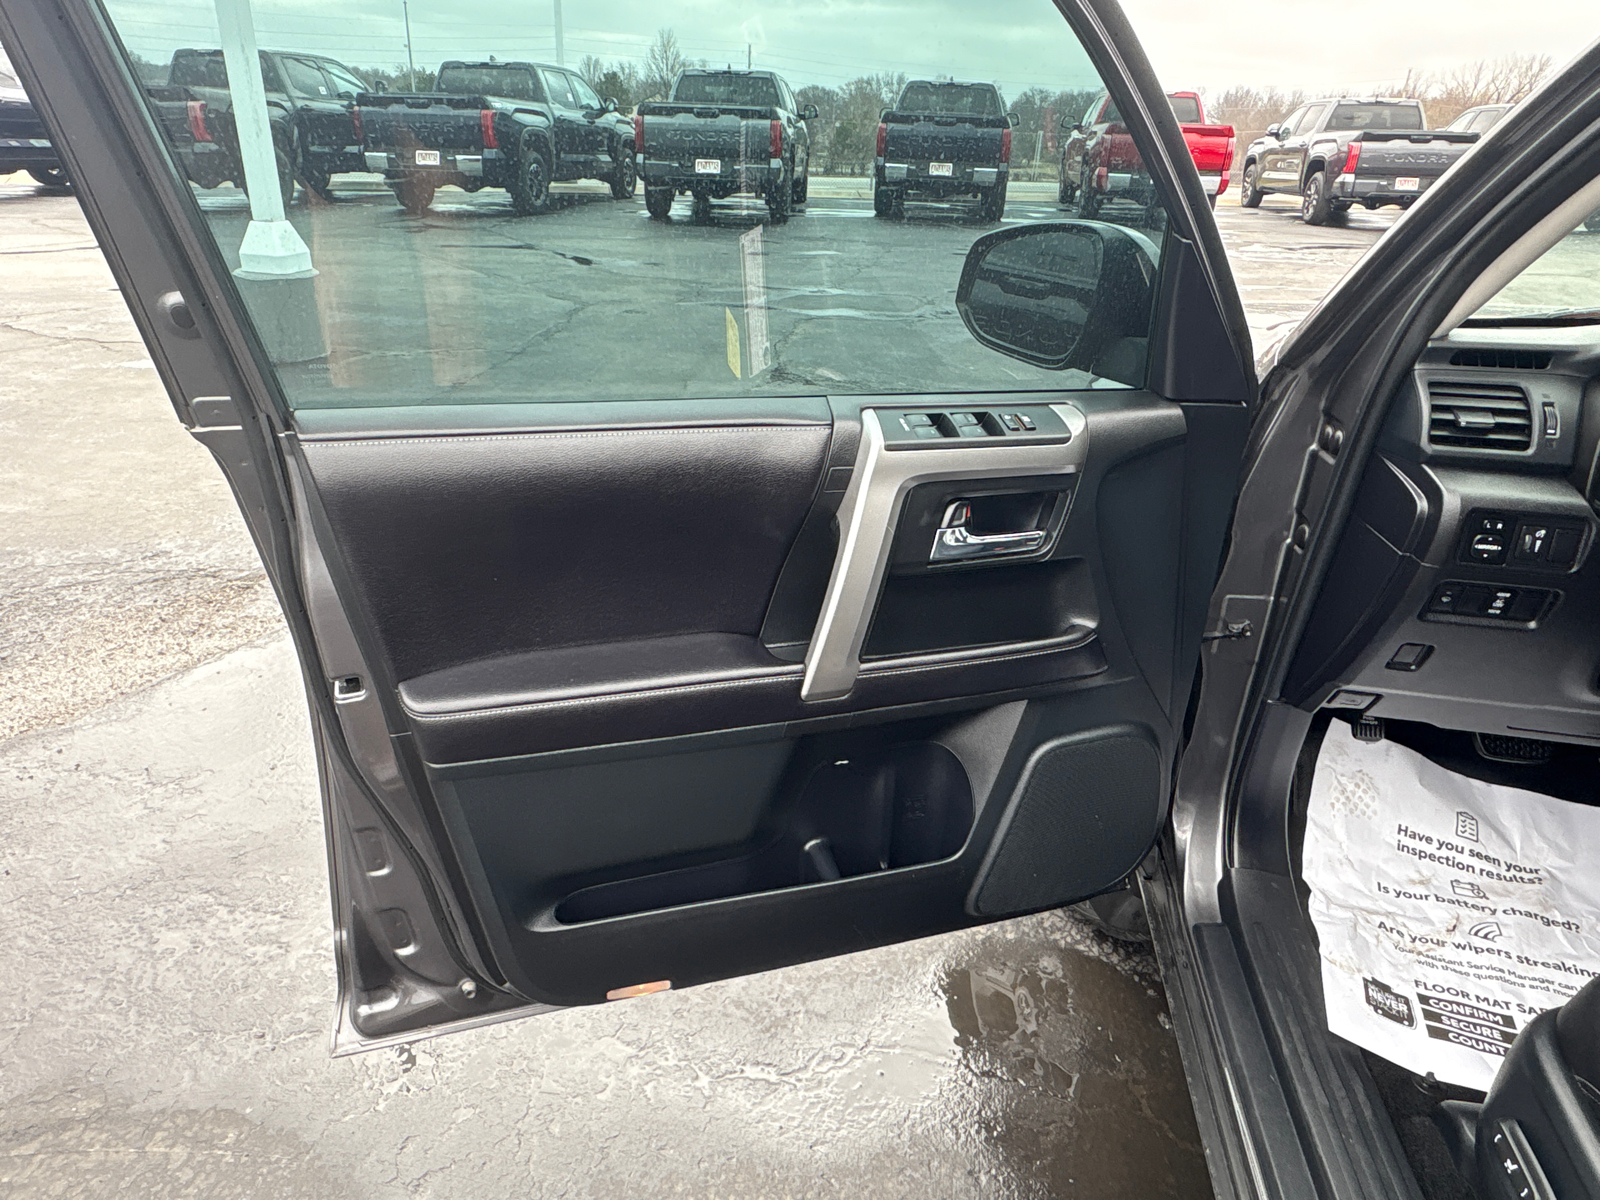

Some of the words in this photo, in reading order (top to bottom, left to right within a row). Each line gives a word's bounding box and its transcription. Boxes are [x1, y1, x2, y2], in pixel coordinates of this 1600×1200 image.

[1384, 153, 1448, 163] TUNDRA
[1396, 839, 1476, 876] inspection
[1479, 864, 1543, 886] results?
[1397, 823, 1433, 846] Have
[1436, 836, 1464, 856] you
[1468, 847, 1501, 868] seen
[1504, 860, 1541, 876] your
[1377, 881, 1390, 894] Is
[1393, 887, 1431, 902] your
[1434, 893, 1497, 917] battery
[1502, 907, 1581, 934] charged?
[1377, 921, 1405, 939] Are
[1408, 933, 1448, 948] your
[1452, 940, 1513, 960] wipers
[1392, 942, 1416, 955] Your
[1417, 950, 1465, 968] Assistant
[1466, 960, 1506, 975] Service
[1507, 968, 1556, 986] Manager
[1557, 981, 1579, 992] can
[1416, 958, 1439, 970] with
[1441, 965, 1471, 977] these
[1472, 972, 1527, 989] questions
[1528, 983, 1551, 993] and
[1368, 987, 1408, 1014] NEVER
[1413, 979, 1473, 1001] FLOOR
[1474, 994, 1512, 1011] MAT
[1428, 998, 1504, 1026] CONFIRM
[1440, 1014, 1504, 1040] SECURE
[1447, 1031, 1507, 1056] COUNT
